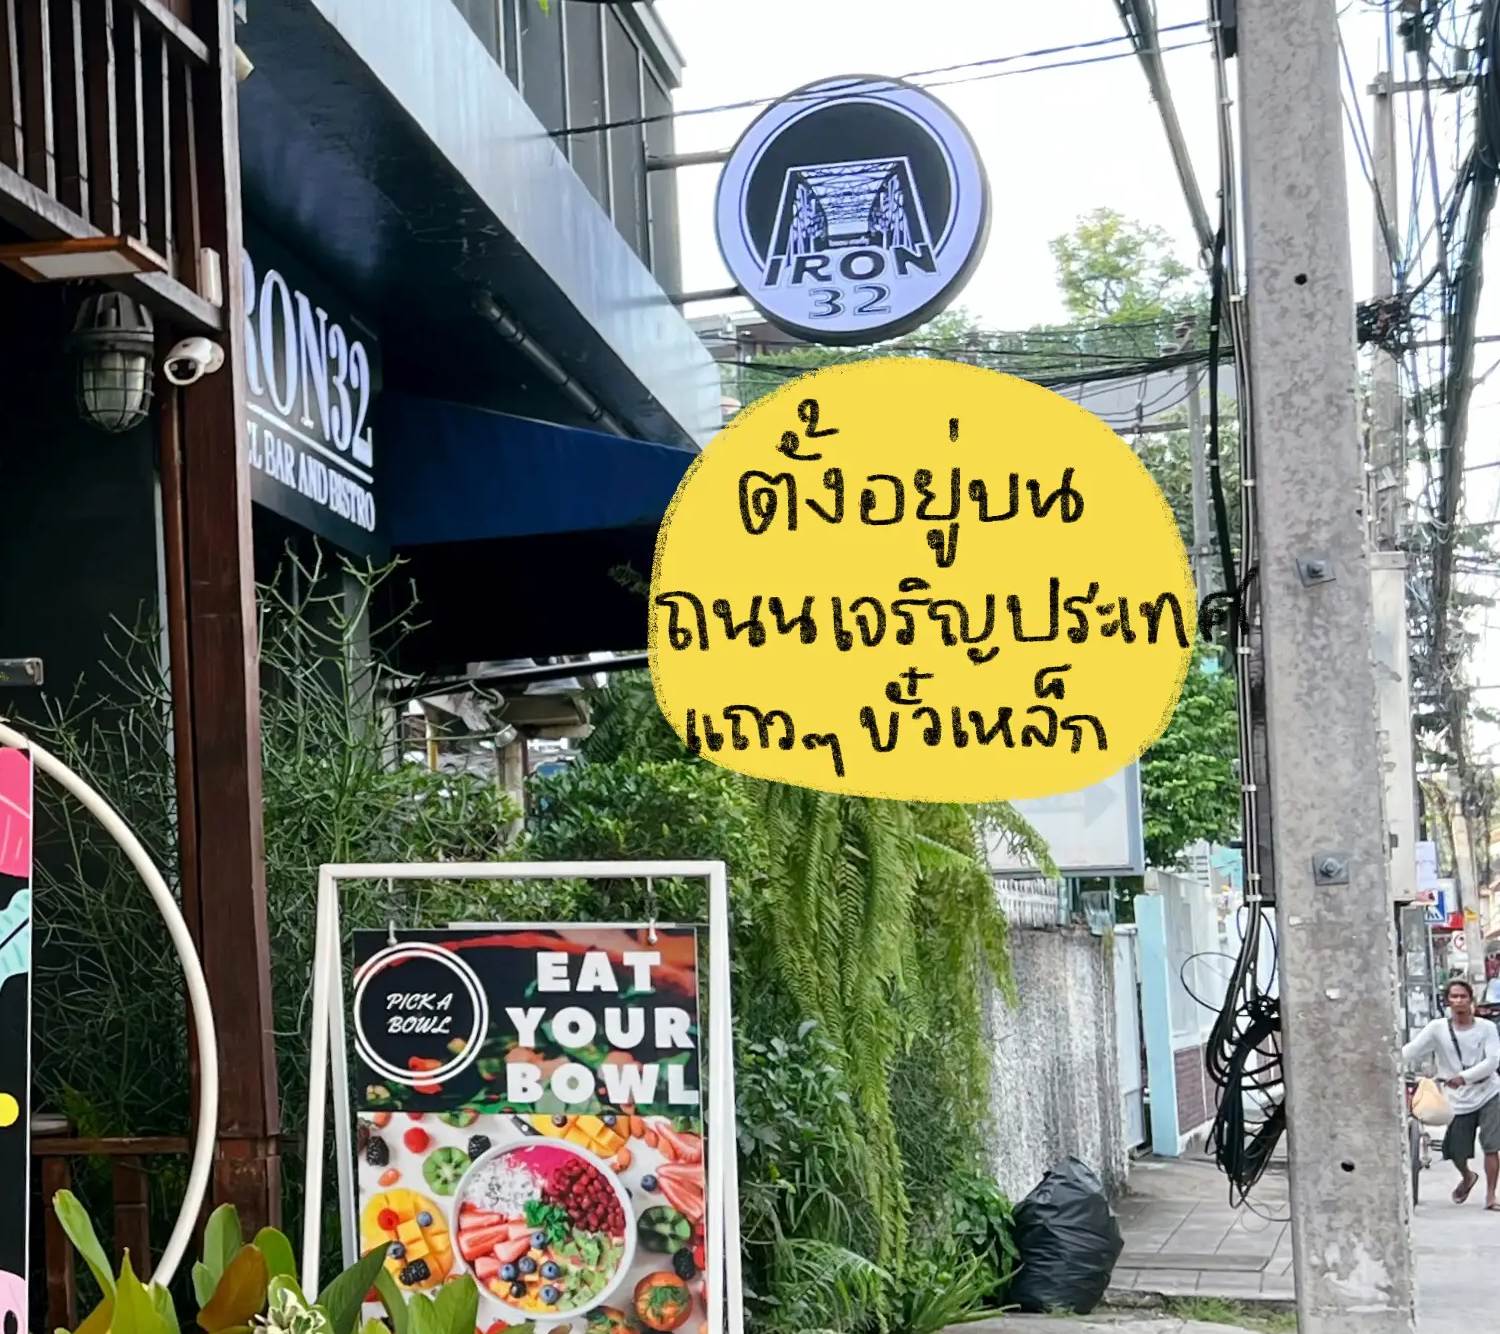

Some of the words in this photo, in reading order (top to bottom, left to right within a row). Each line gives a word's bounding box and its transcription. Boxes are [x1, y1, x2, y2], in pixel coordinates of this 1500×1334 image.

[760, 242, 941, 289] IRON
[808, 283, 891, 319] 32
[264, 429, 296, 489] BAR
[298, 452, 328, 505] AND
[328, 468, 375, 532] BISTRO
[536, 951, 661, 993] EAT
[386, 992, 436, 1011] PICK
[437, 992, 454, 1011] A
[387, 1016, 450, 1035] BOWL
[505, 1007, 696, 1049] YOUR
[506, 1063, 699, 1105] BOWL
